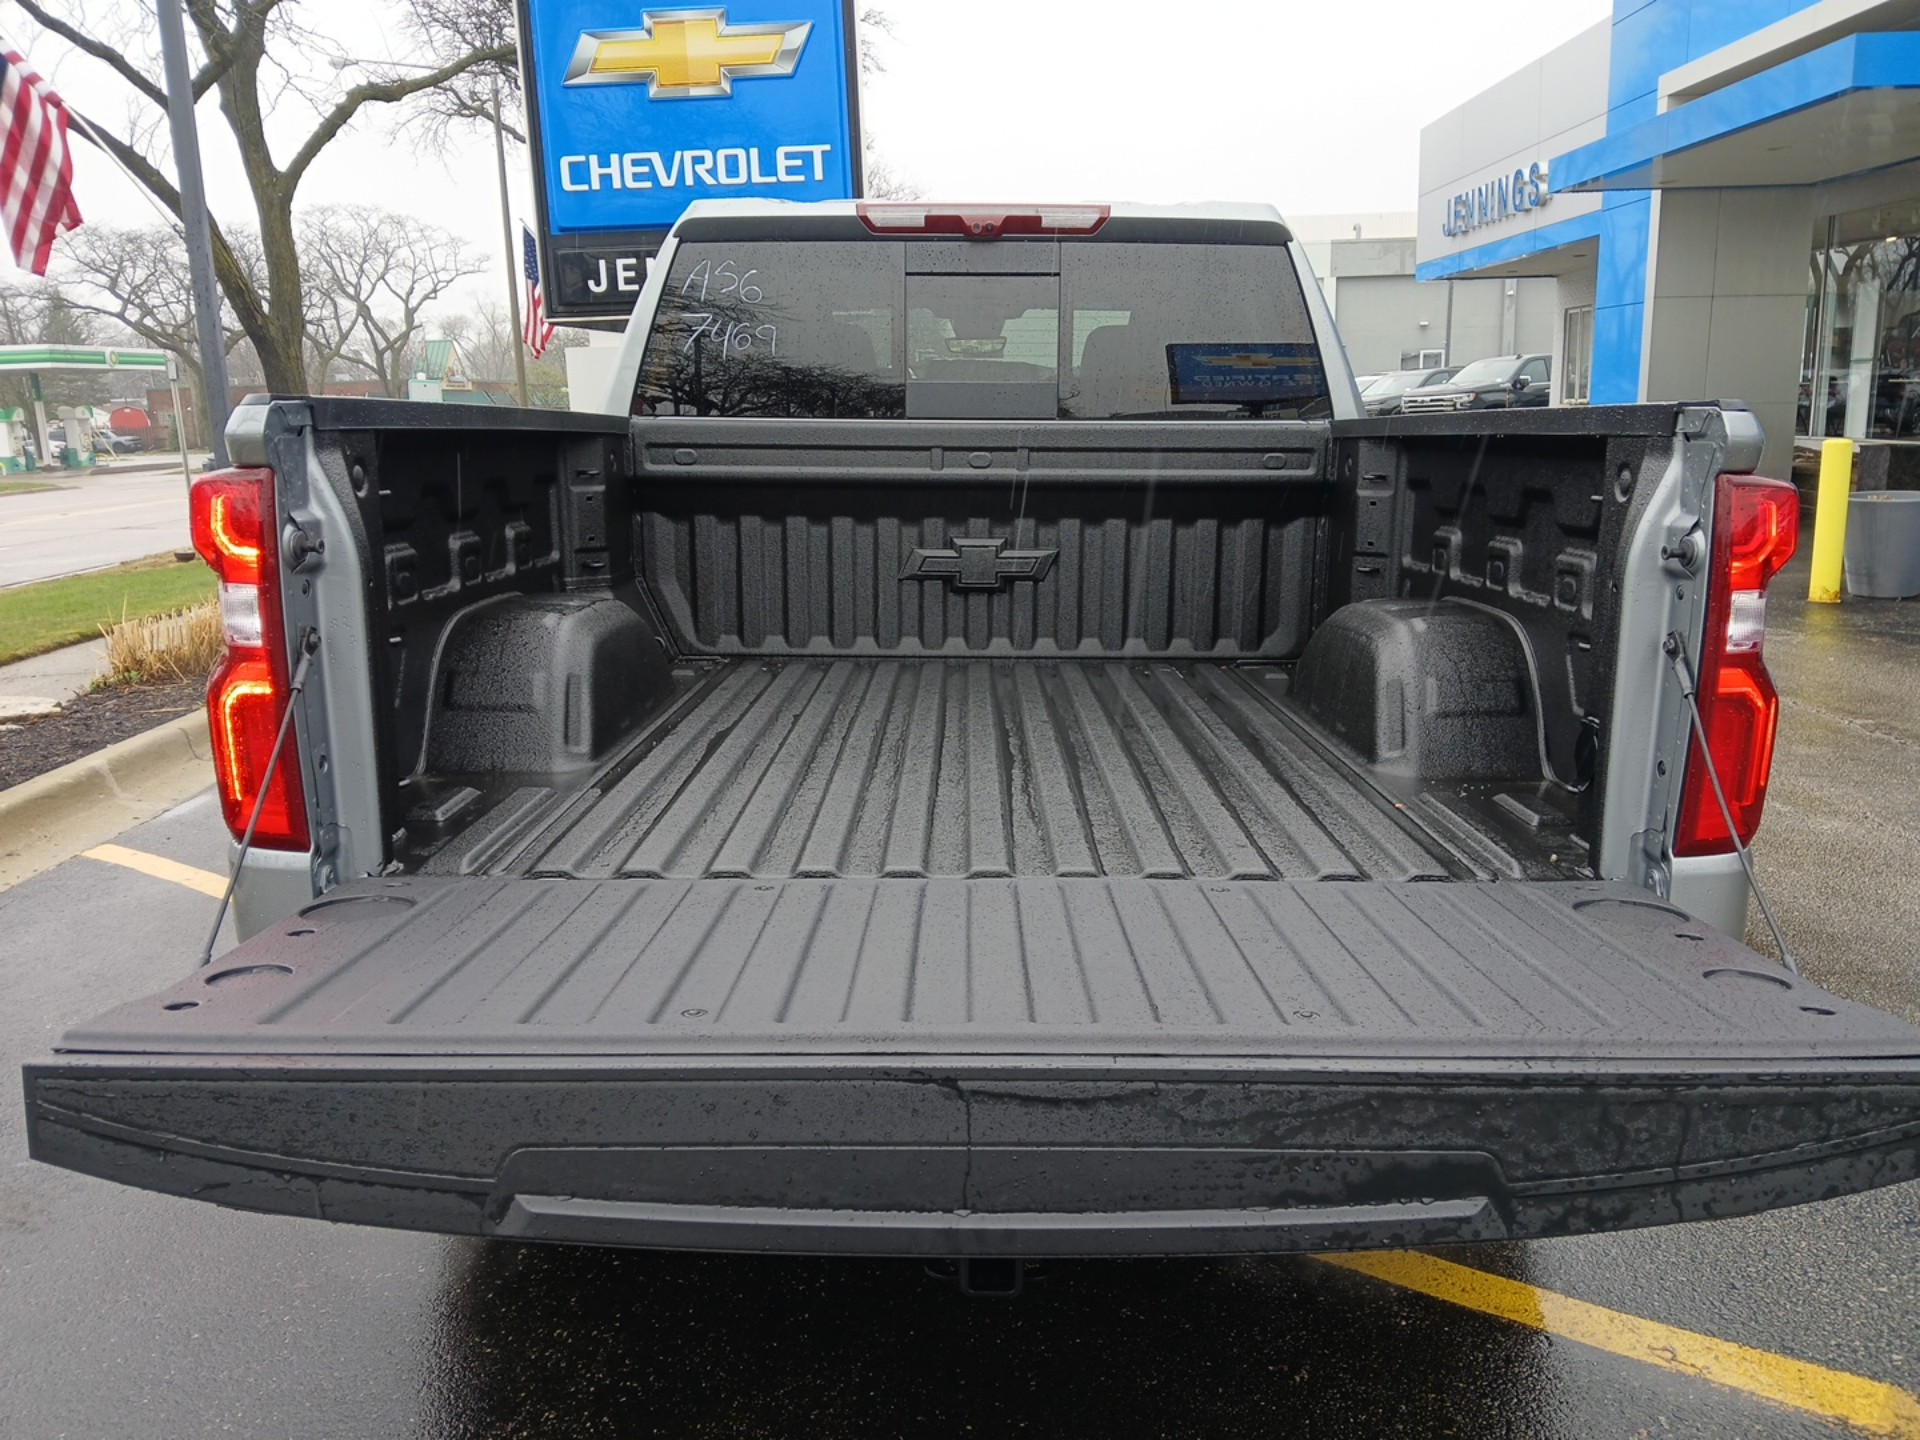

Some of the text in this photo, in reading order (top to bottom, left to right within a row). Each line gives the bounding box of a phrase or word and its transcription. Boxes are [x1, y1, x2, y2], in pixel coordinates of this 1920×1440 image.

[560, 145, 831, 191] CHEVROLET
[1442, 161, 1543, 237] JENNINGS
[587, 257, 656, 293] JE
[680, 313, 776, 362] 7469
